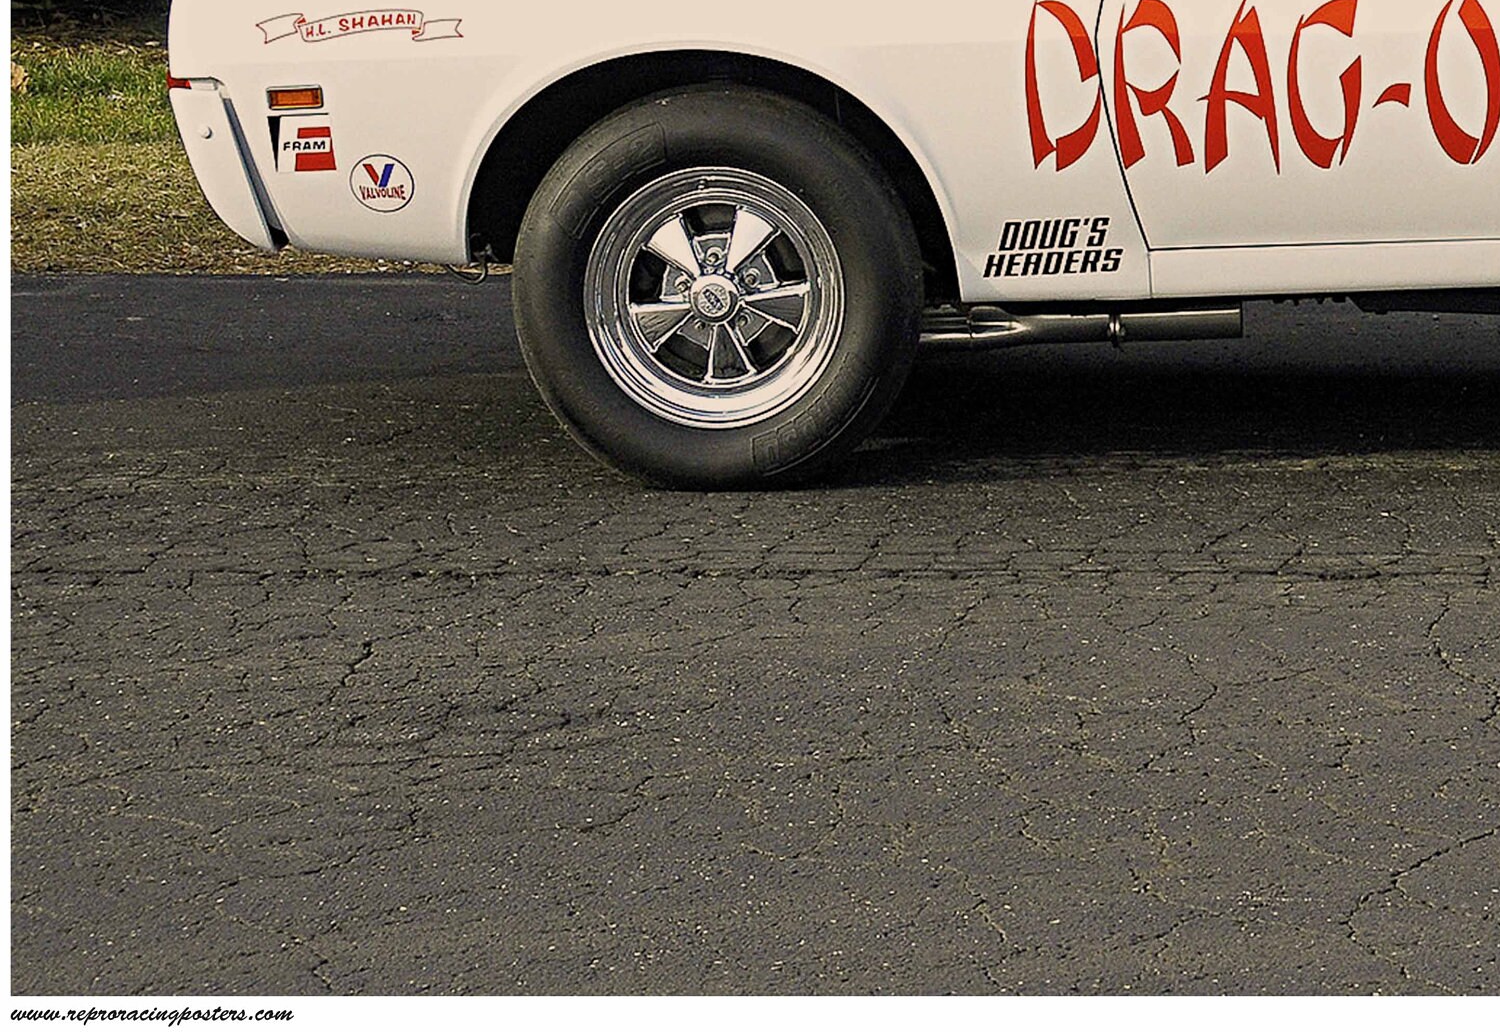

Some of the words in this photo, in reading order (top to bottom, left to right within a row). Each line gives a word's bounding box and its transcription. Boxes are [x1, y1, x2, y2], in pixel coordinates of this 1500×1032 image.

[305, 24, 331, 38] H.L.
[338, 13, 416, 32] SHAHAN
[283, 139, 326, 151] FRAM
[359, 184, 406, 201] VALVOLINE
[998, 217, 1111, 252] DOUG'S
[982, 248, 1124, 278] HEADERS
